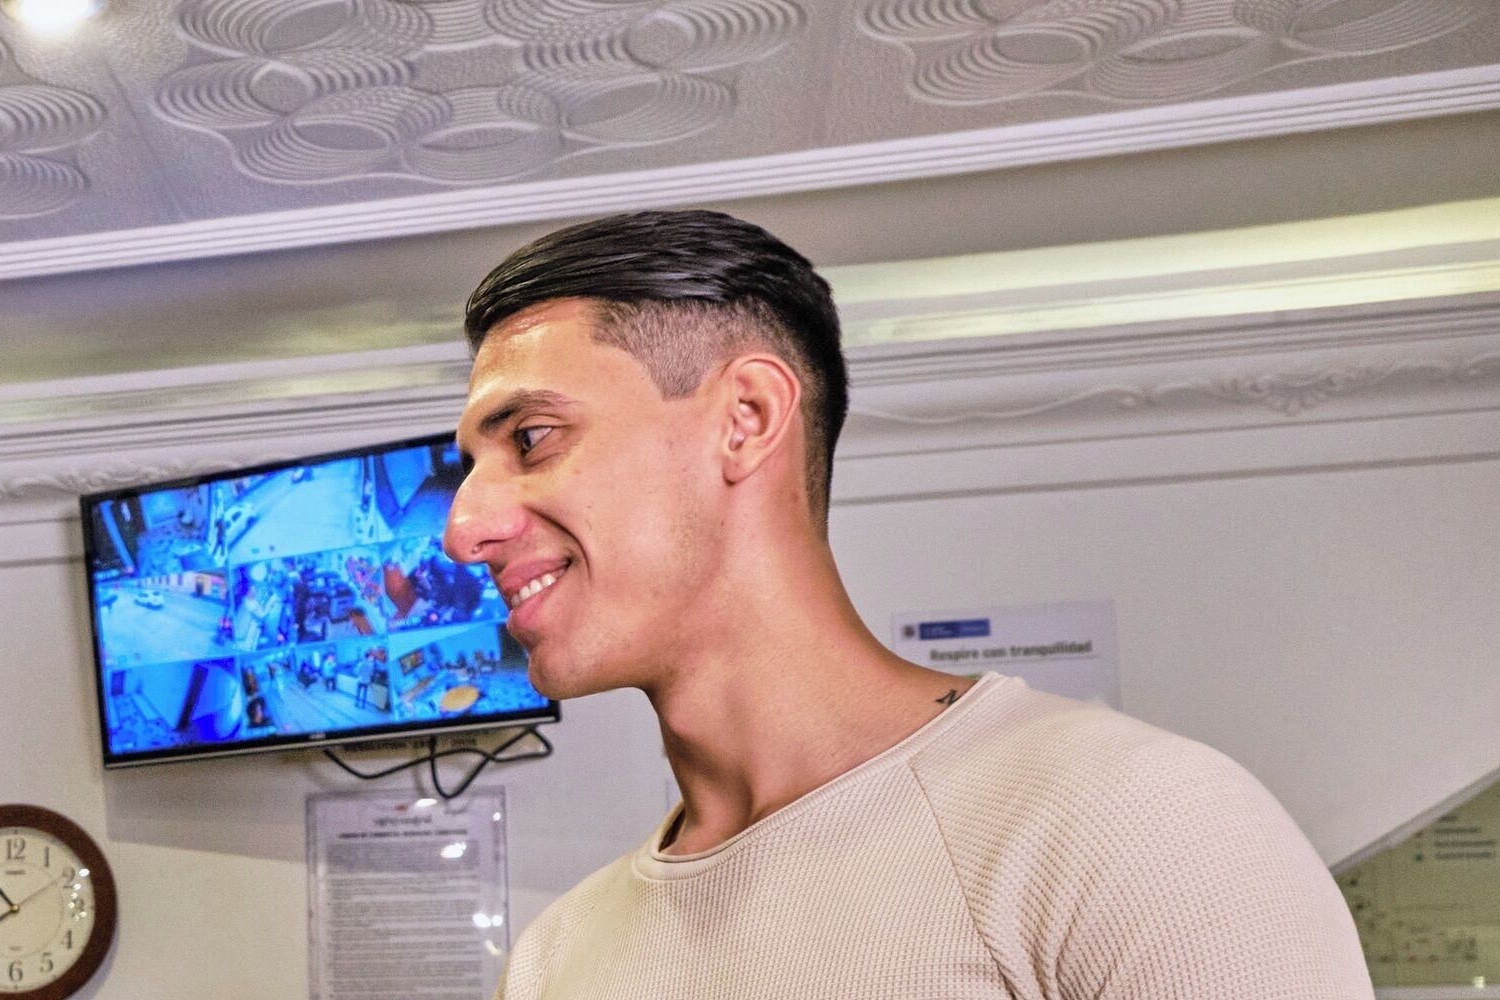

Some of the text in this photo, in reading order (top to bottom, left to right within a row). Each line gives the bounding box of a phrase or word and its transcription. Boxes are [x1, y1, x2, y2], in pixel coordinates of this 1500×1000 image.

[929, 640, 1093, 663] Respire con tranquilidad
[6, 838, 26, 860] 12
[43, 846, 51, 868] 1
[62, 866, 77, 889] 2
[60, 930, 74, 949] 4
[8, 962, 24, 982] 6
[40, 953, 55, 972] 5
